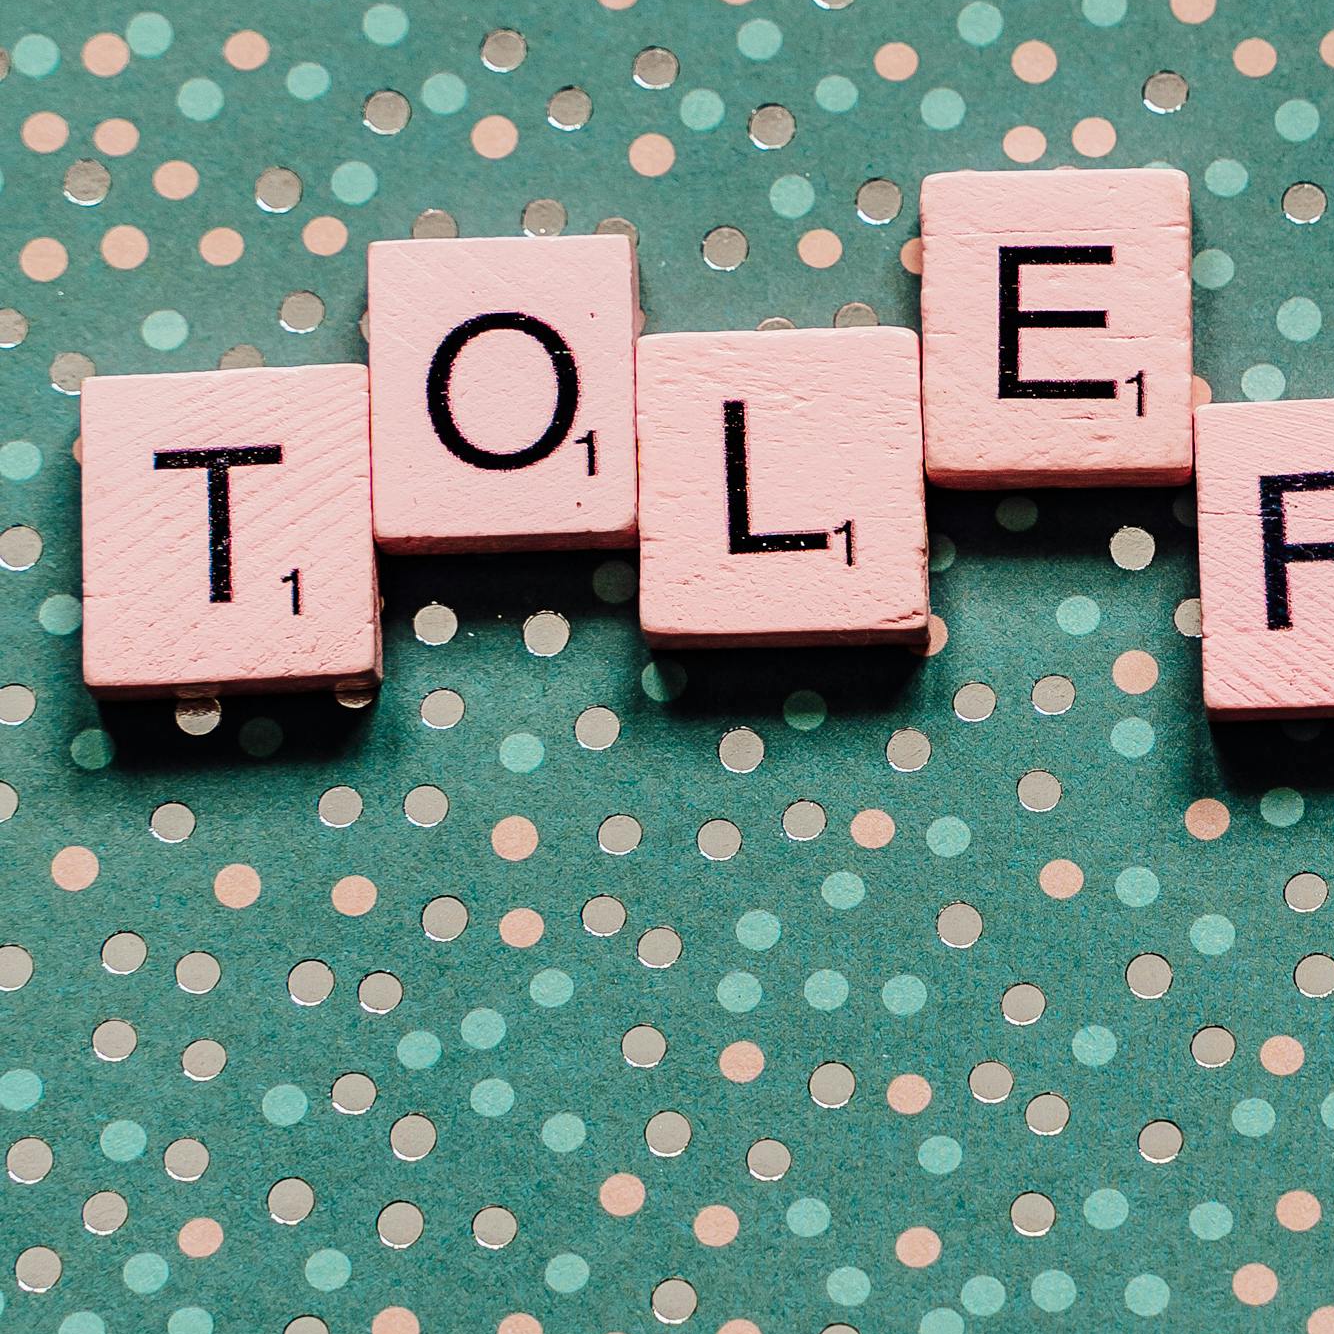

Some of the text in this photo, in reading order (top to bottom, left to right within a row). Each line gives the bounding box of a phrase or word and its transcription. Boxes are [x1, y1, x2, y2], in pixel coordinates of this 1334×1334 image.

[1123, 369, 1146, 418] 1
[573, 428, 599, 478] 1
[831, 519, 856, 568] 1
[279, 568, 302, 616] 1
